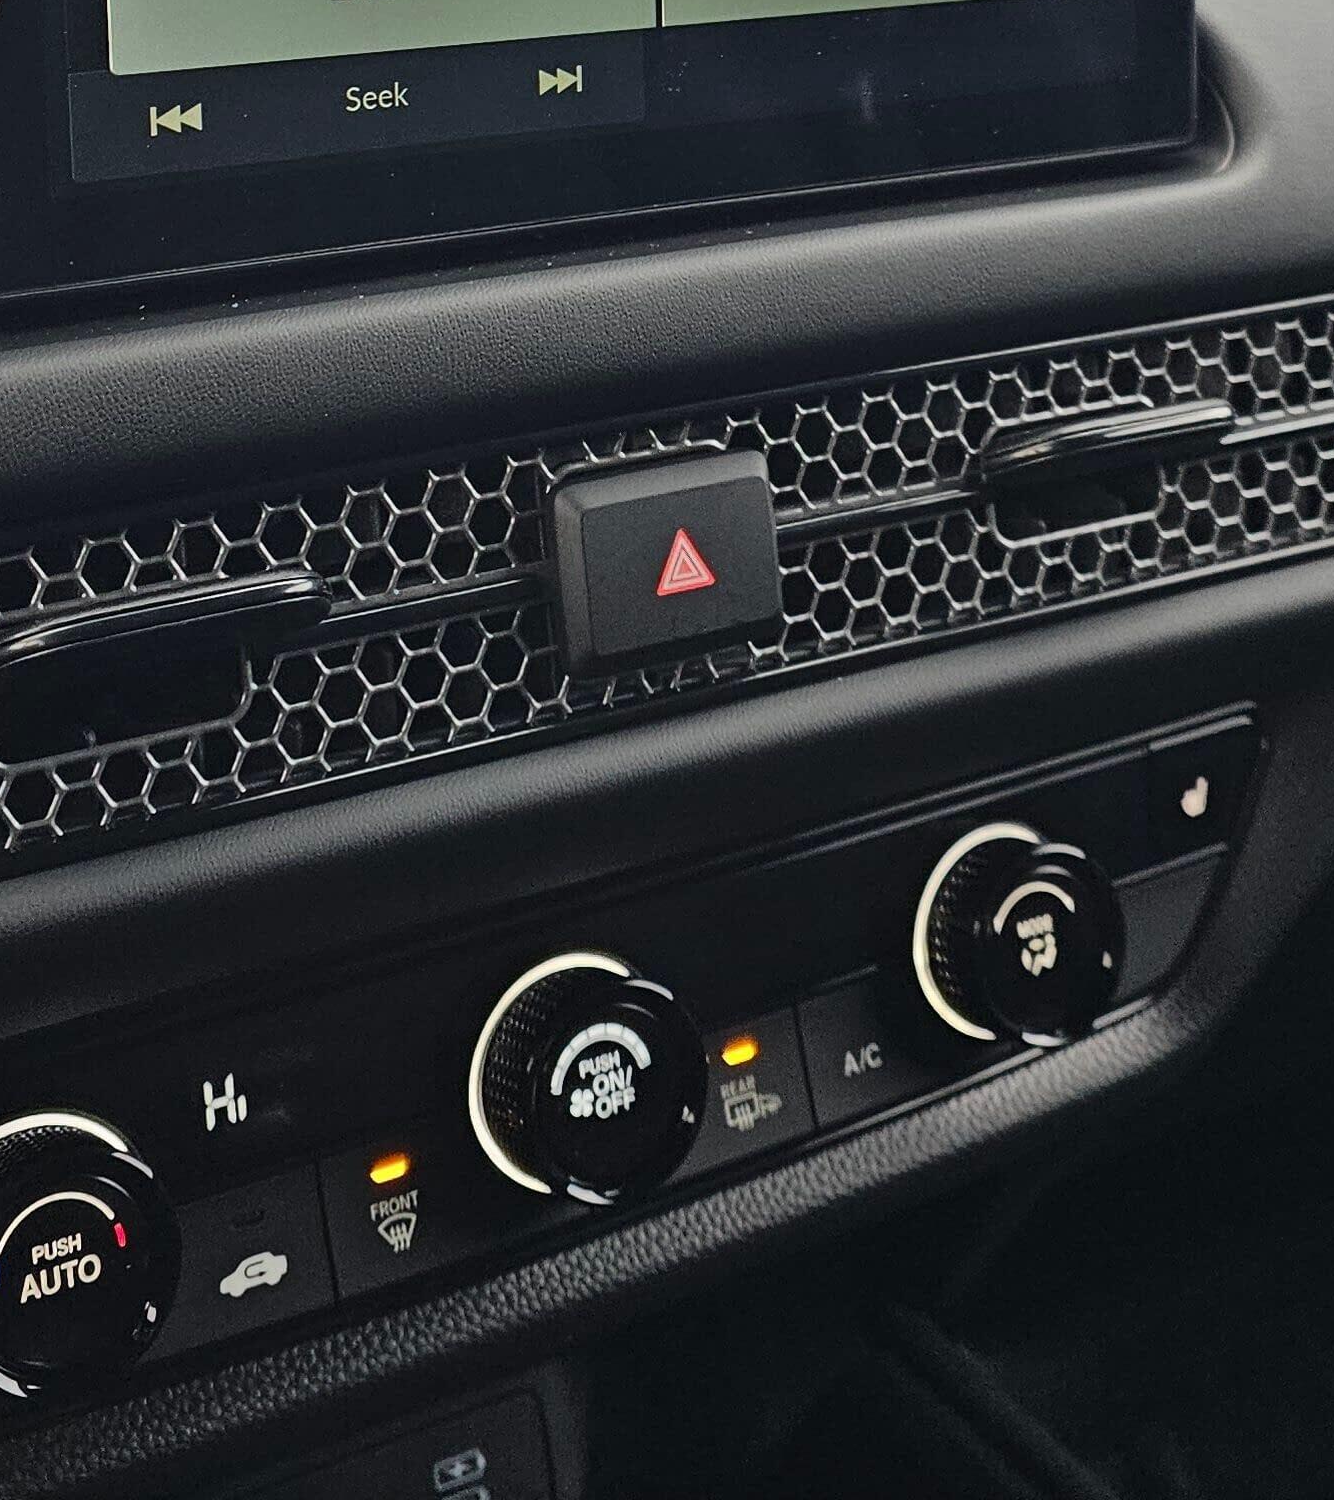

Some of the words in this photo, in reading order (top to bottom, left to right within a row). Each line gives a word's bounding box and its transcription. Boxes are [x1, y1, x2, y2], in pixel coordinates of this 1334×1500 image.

[346, 82, 408, 111] Seek
[578, 1049, 621, 1080] PUSH
[844, 1043, 882, 1077] A/C
[592, 1064, 633, 1097] ON/
[595, 1087, 636, 1119] OFF
[370, 1189, 419, 1221] FRONT
[31, 1233, 82, 1264] PUSH
[20, 1253, 102, 1304] AUTO
